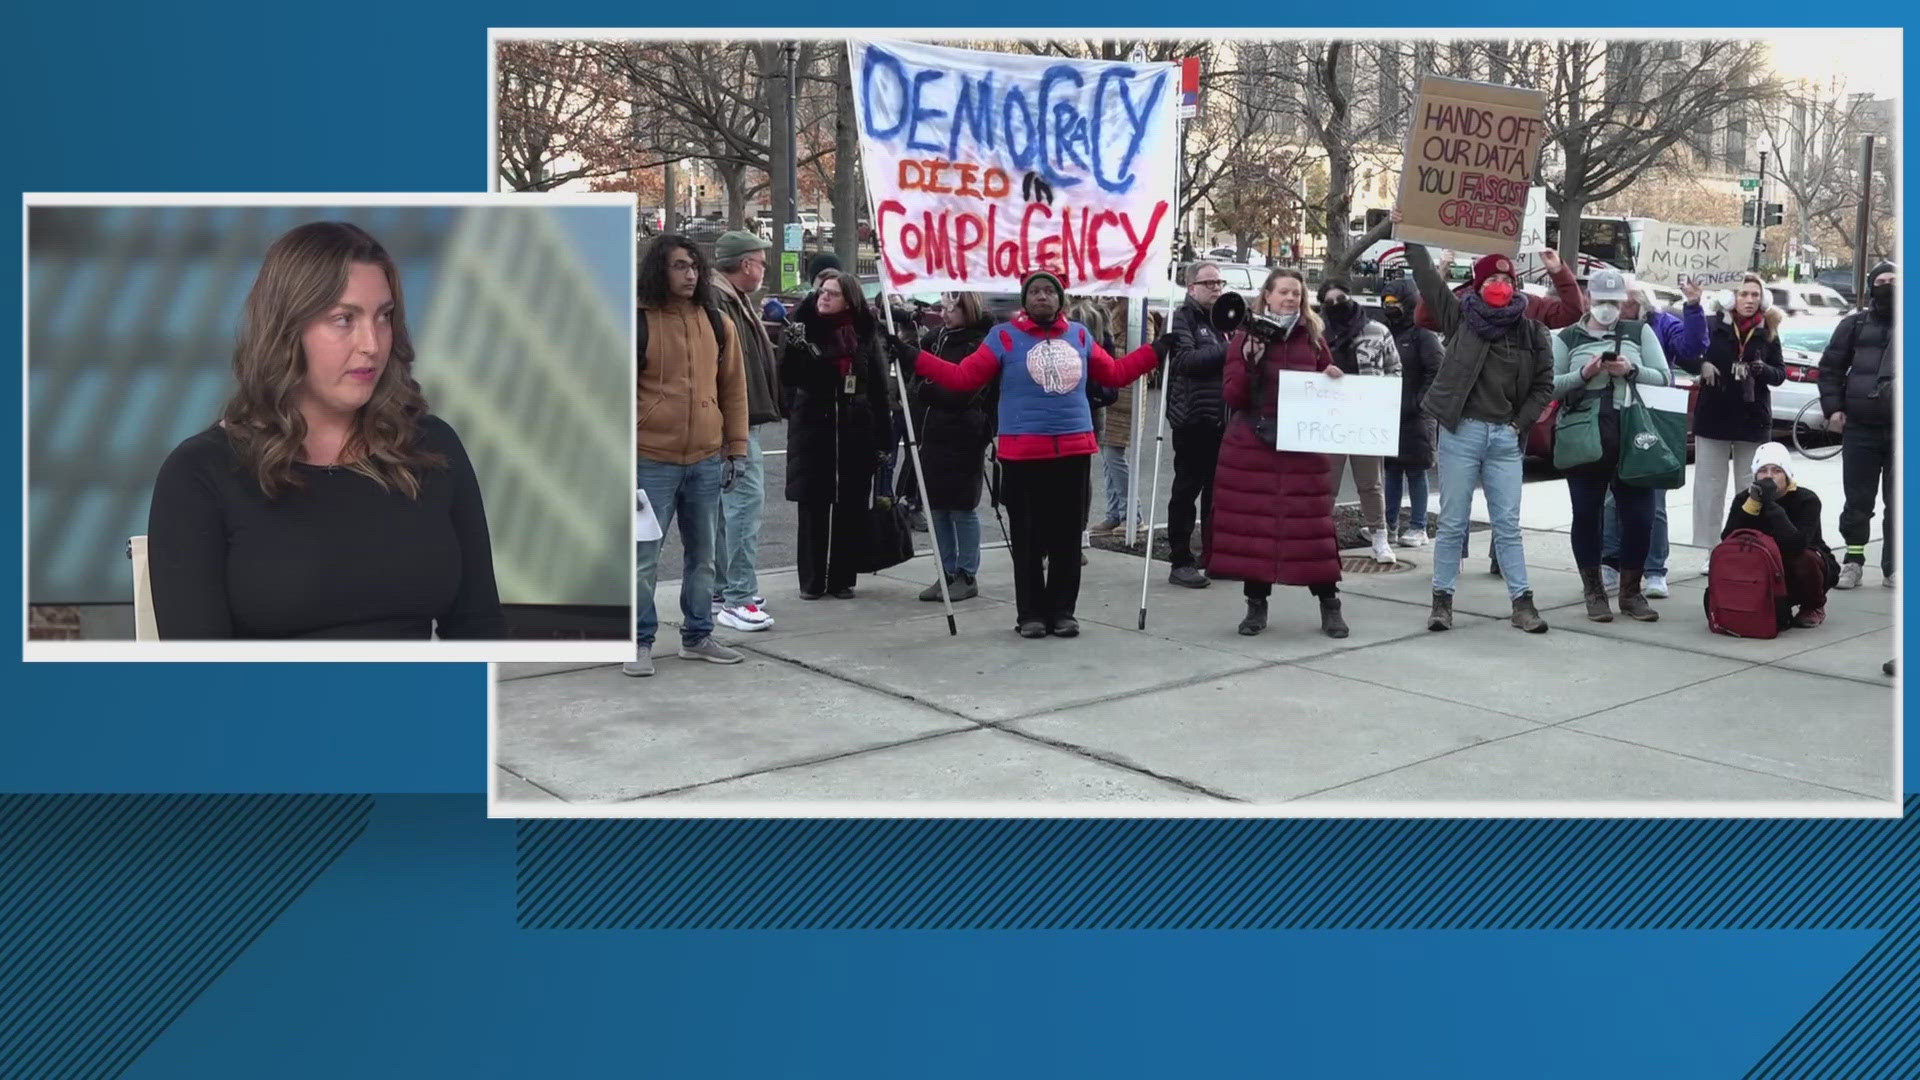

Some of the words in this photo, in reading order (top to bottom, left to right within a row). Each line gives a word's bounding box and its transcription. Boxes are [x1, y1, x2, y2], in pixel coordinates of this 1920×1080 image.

[862, 45, 1167, 194] DEMOCRACY
[1424, 102, 1493, 139] HANDS
[1498, 115, 1541, 147] OFF
[1423, 136, 1471, 166] OUR
[1474, 142, 1530, 180] DATA,
[898, 159, 1010, 200] DIED
[1418, 165, 1454, 195] YOU
[1458, 171, 1531, 208] FASCIST
[1438, 199, 1522, 236] CREEPS
[1651, 249, 1720, 270] MUSK
[1666, 227, 1730, 252] FORK
[1677, 271, 1745, 287] ENGINEERS
